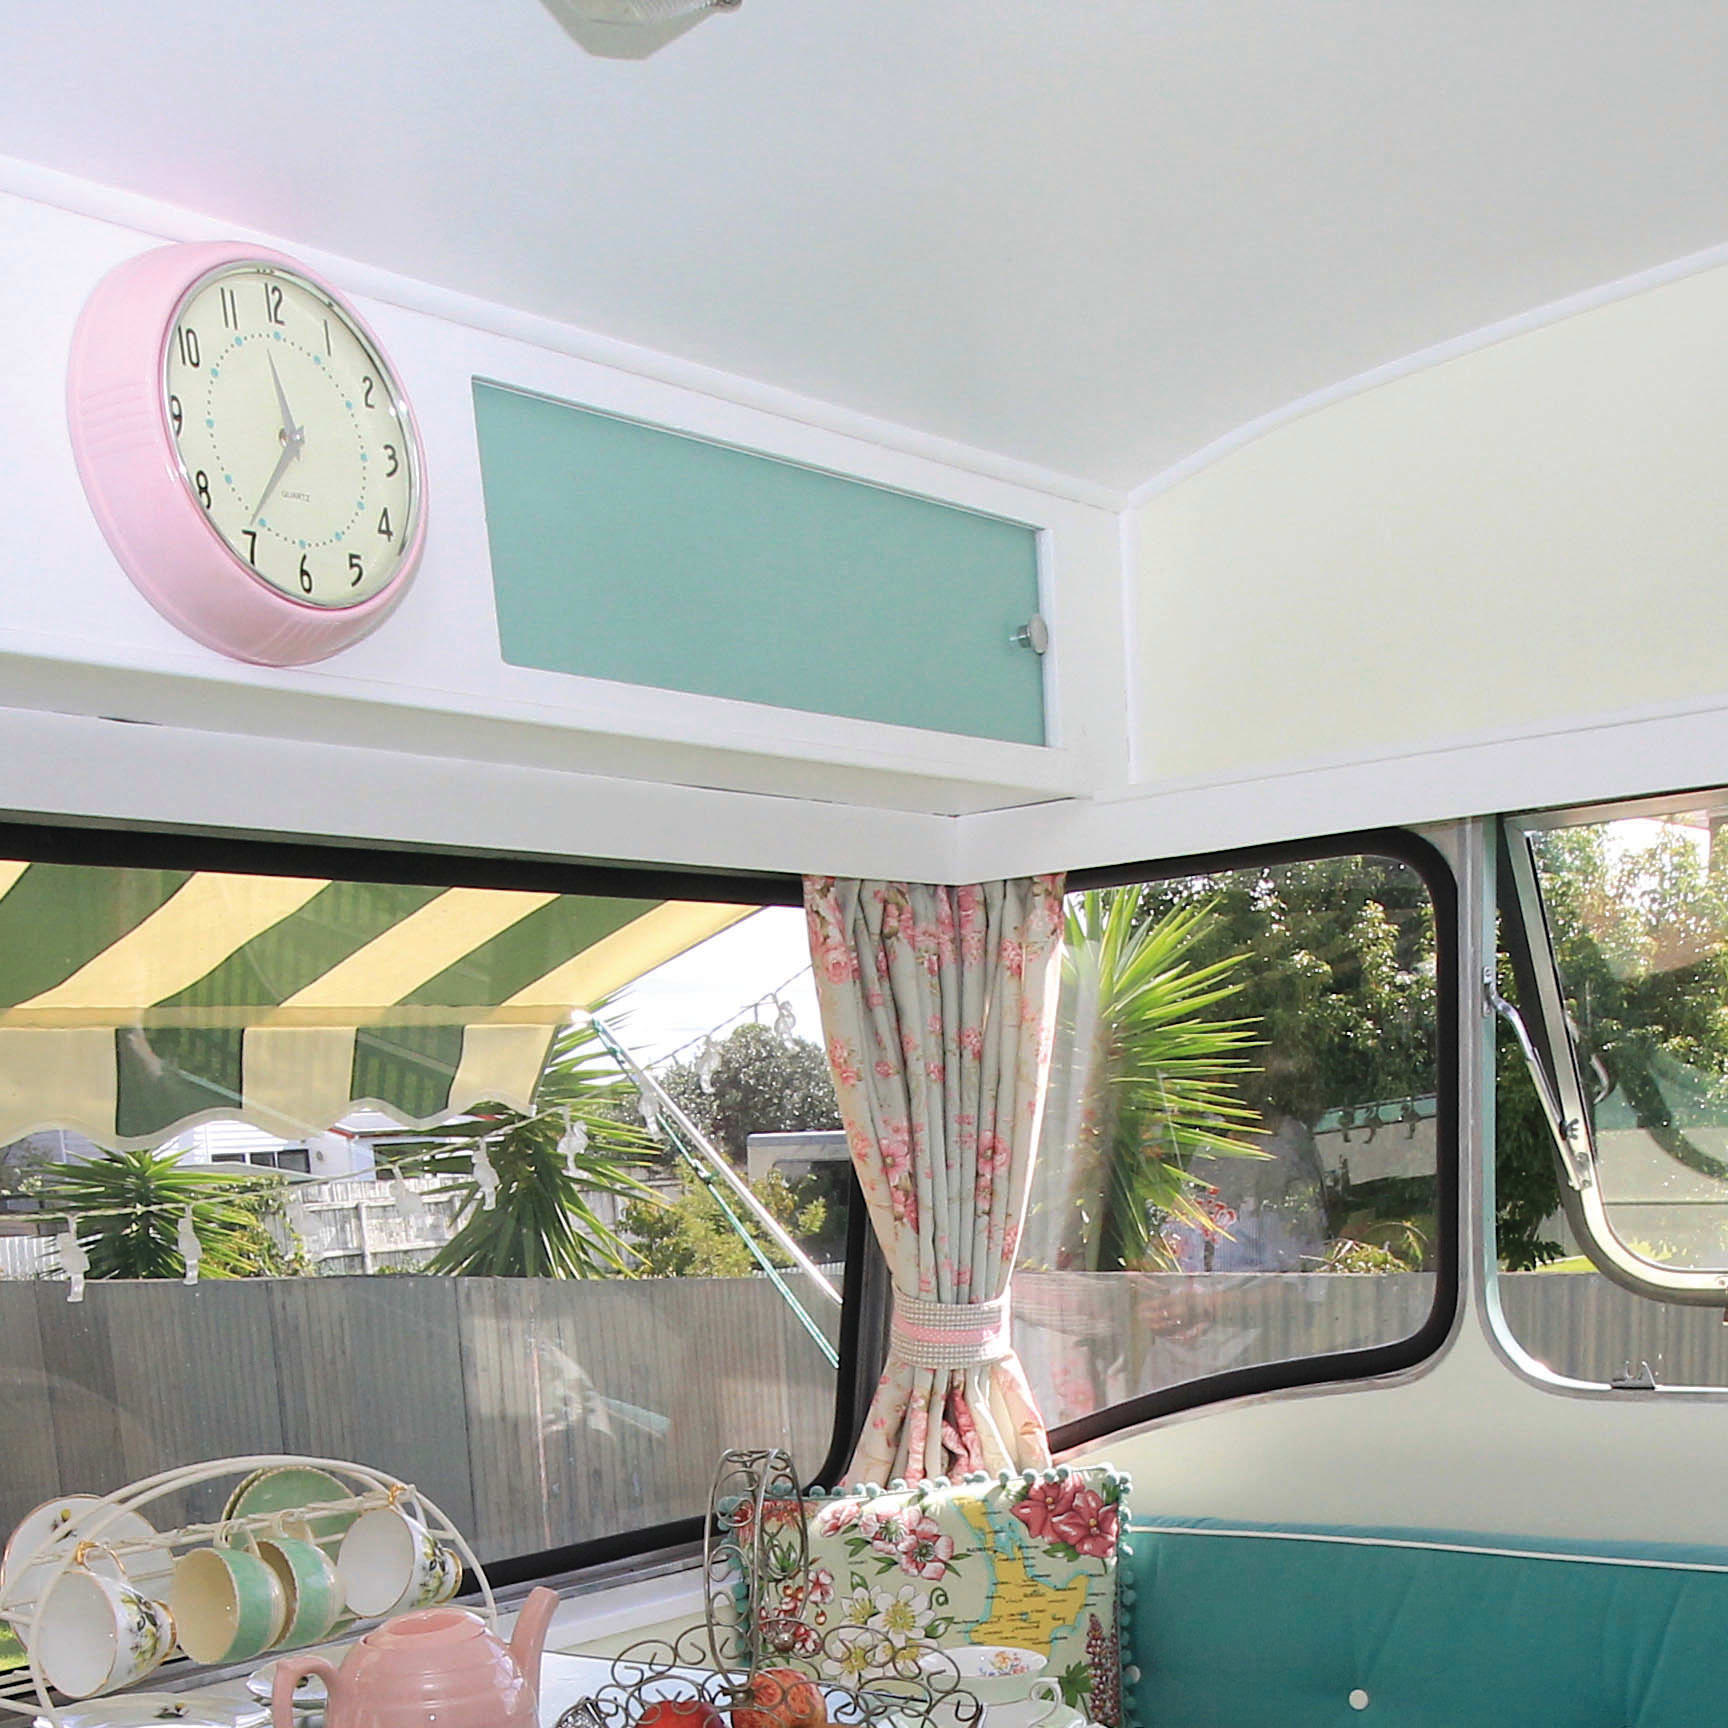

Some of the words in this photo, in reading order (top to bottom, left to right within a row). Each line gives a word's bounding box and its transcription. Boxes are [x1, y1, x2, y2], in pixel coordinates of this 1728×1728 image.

[219, 287, 239, 330] 11
[264, 283, 285, 326] 12
[177, 325, 201, 368] 10
[323, 319, 332, 357] 1
[362, 376, 376, 408] 2
[171, 394, 183, 438] 9
[382, 444, 399, 478] 3
[195, 470, 212, 510] 8
[280, 489, 311, 503] QUARTZ
[376, 507, 394, 543] 4
[241, 530, 257, 567] 7
[299, 554, 314, 595] 6
[348, 553, 364, 588] 5
